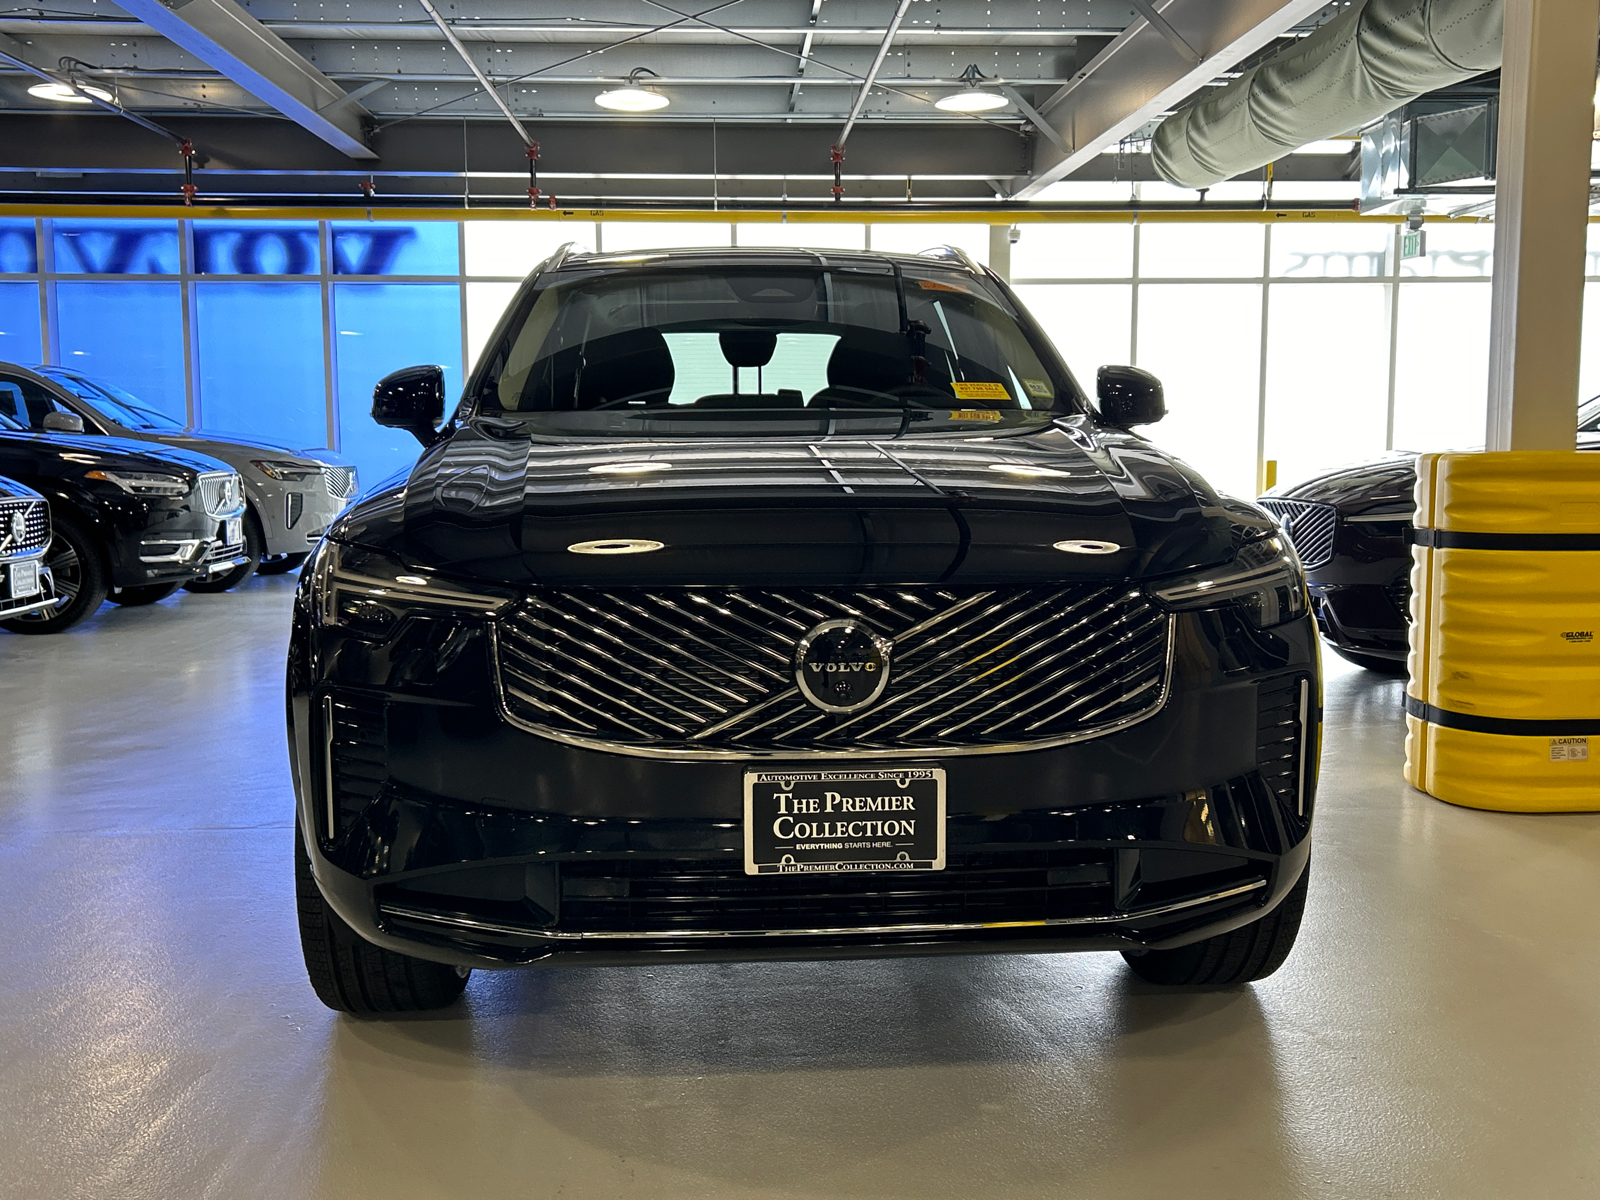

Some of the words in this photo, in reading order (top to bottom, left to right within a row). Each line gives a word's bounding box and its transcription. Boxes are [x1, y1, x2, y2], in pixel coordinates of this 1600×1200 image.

[1403, 234, 1418, 257] EXIT
[809, 662, 876, 672] VOLVO
[760, 773, 819, 781] AUTOMOTIVE
[821, 772, 876, 780] EXCELLENCE
[878, 771, 904, 779] SINCE
[908, 770, 932, 778] 1995
[773, 793, 820, 814] THE
[824, 792, 916, 813] PREMIER
[773, 816, 916, 839] COLLECTION
